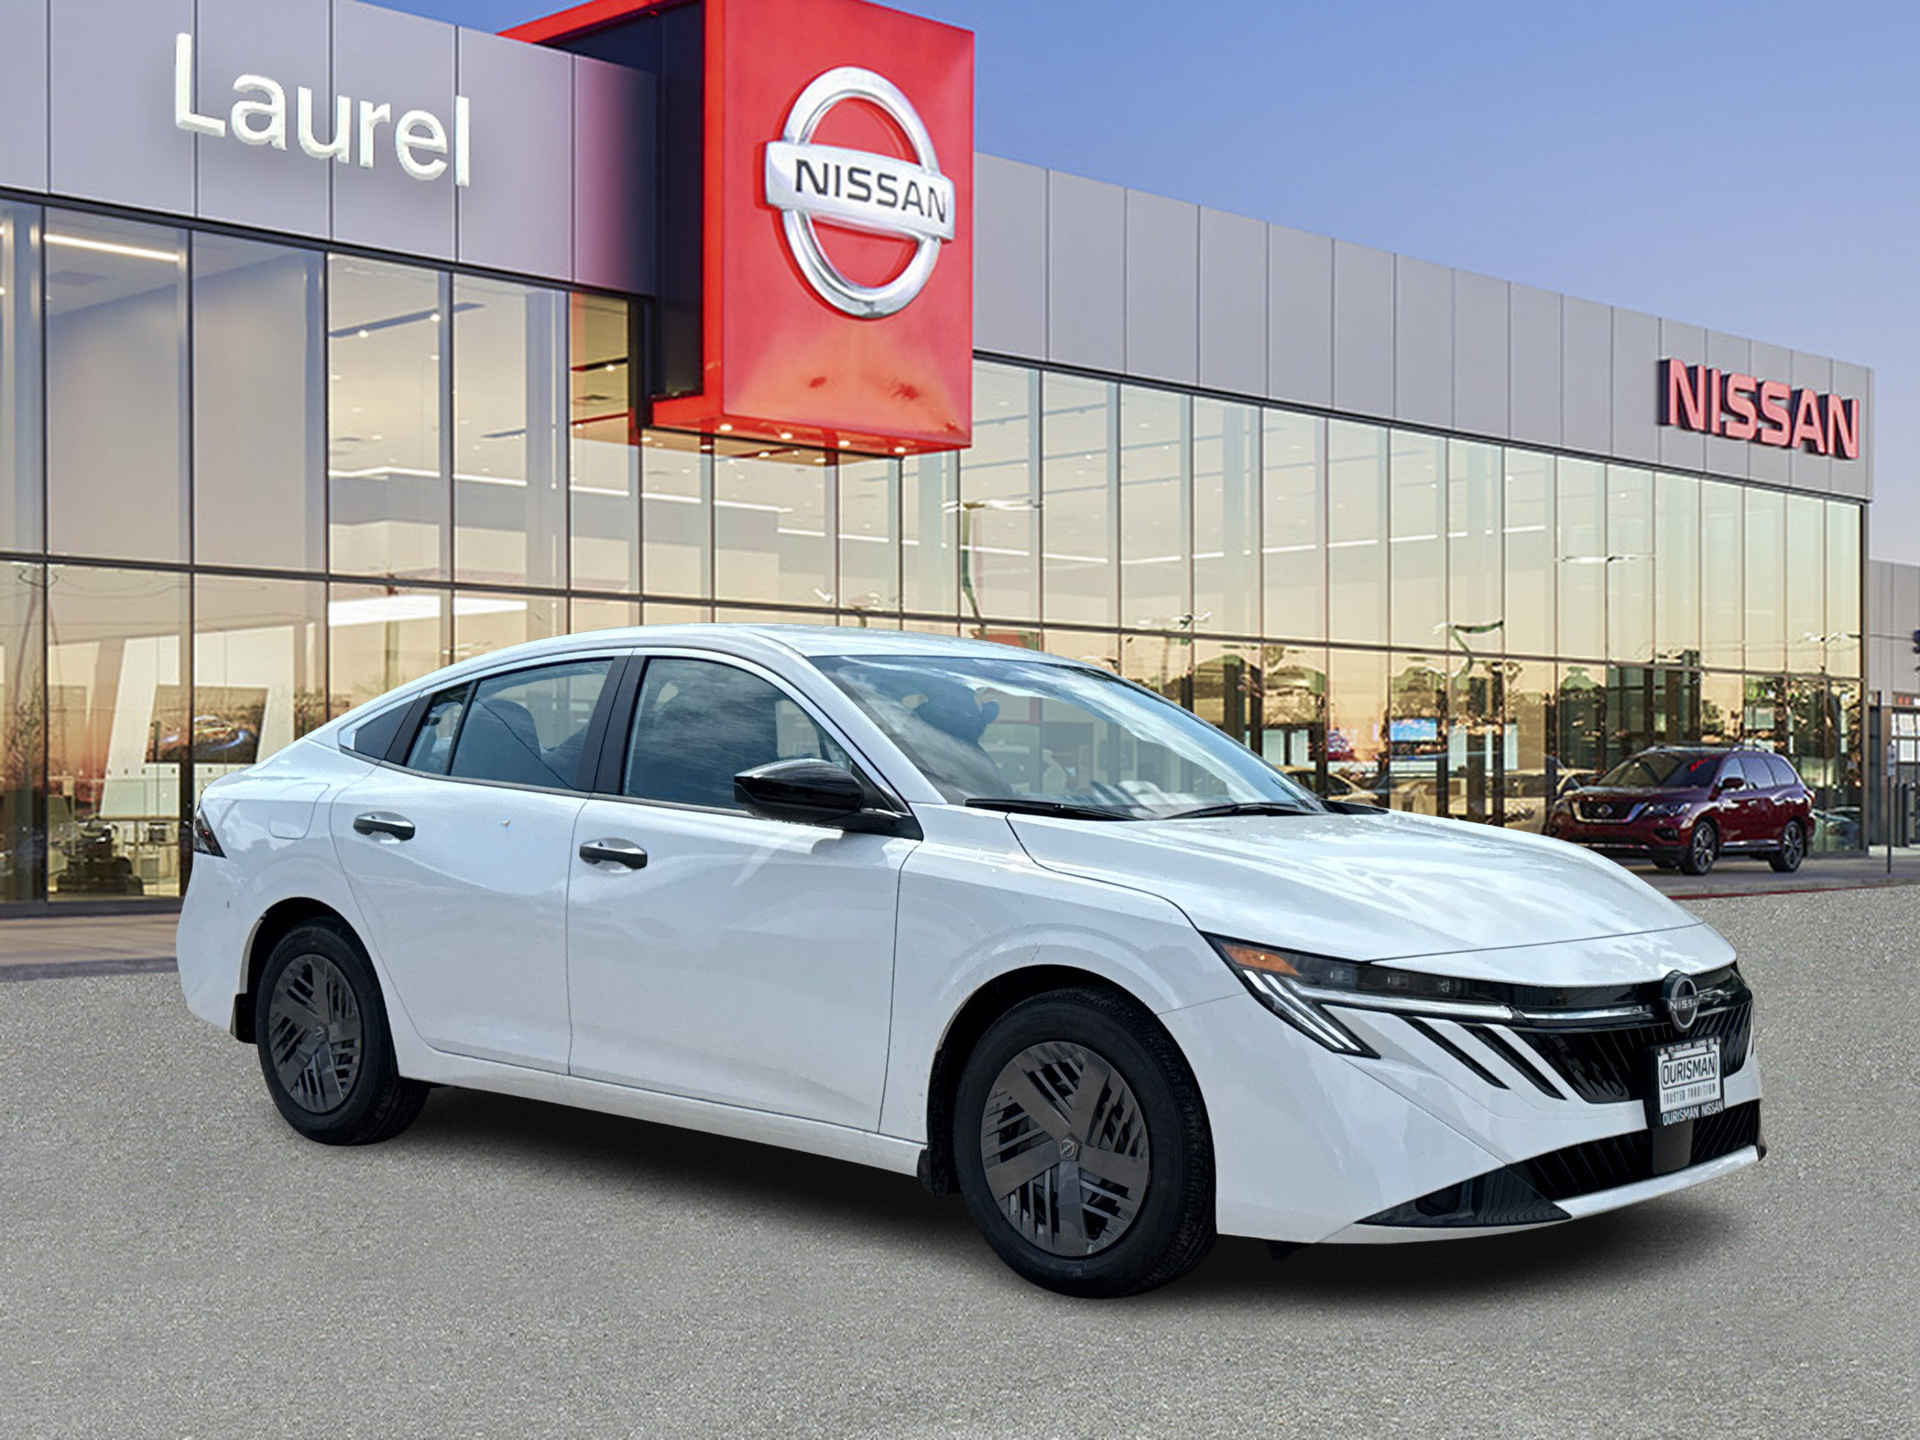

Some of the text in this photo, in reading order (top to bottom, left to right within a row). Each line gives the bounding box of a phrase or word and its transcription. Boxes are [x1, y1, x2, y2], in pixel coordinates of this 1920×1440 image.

[175, 33, 470, 188] Laurel
[795, 158, 947, 224] NISSAN
[1659, 358, 1860, 459] NISSAN
[1663, 1058, 1715, 1085] OURISMAN
[1662, 1100, 1723, 1126] OURISMAN NISSAN
